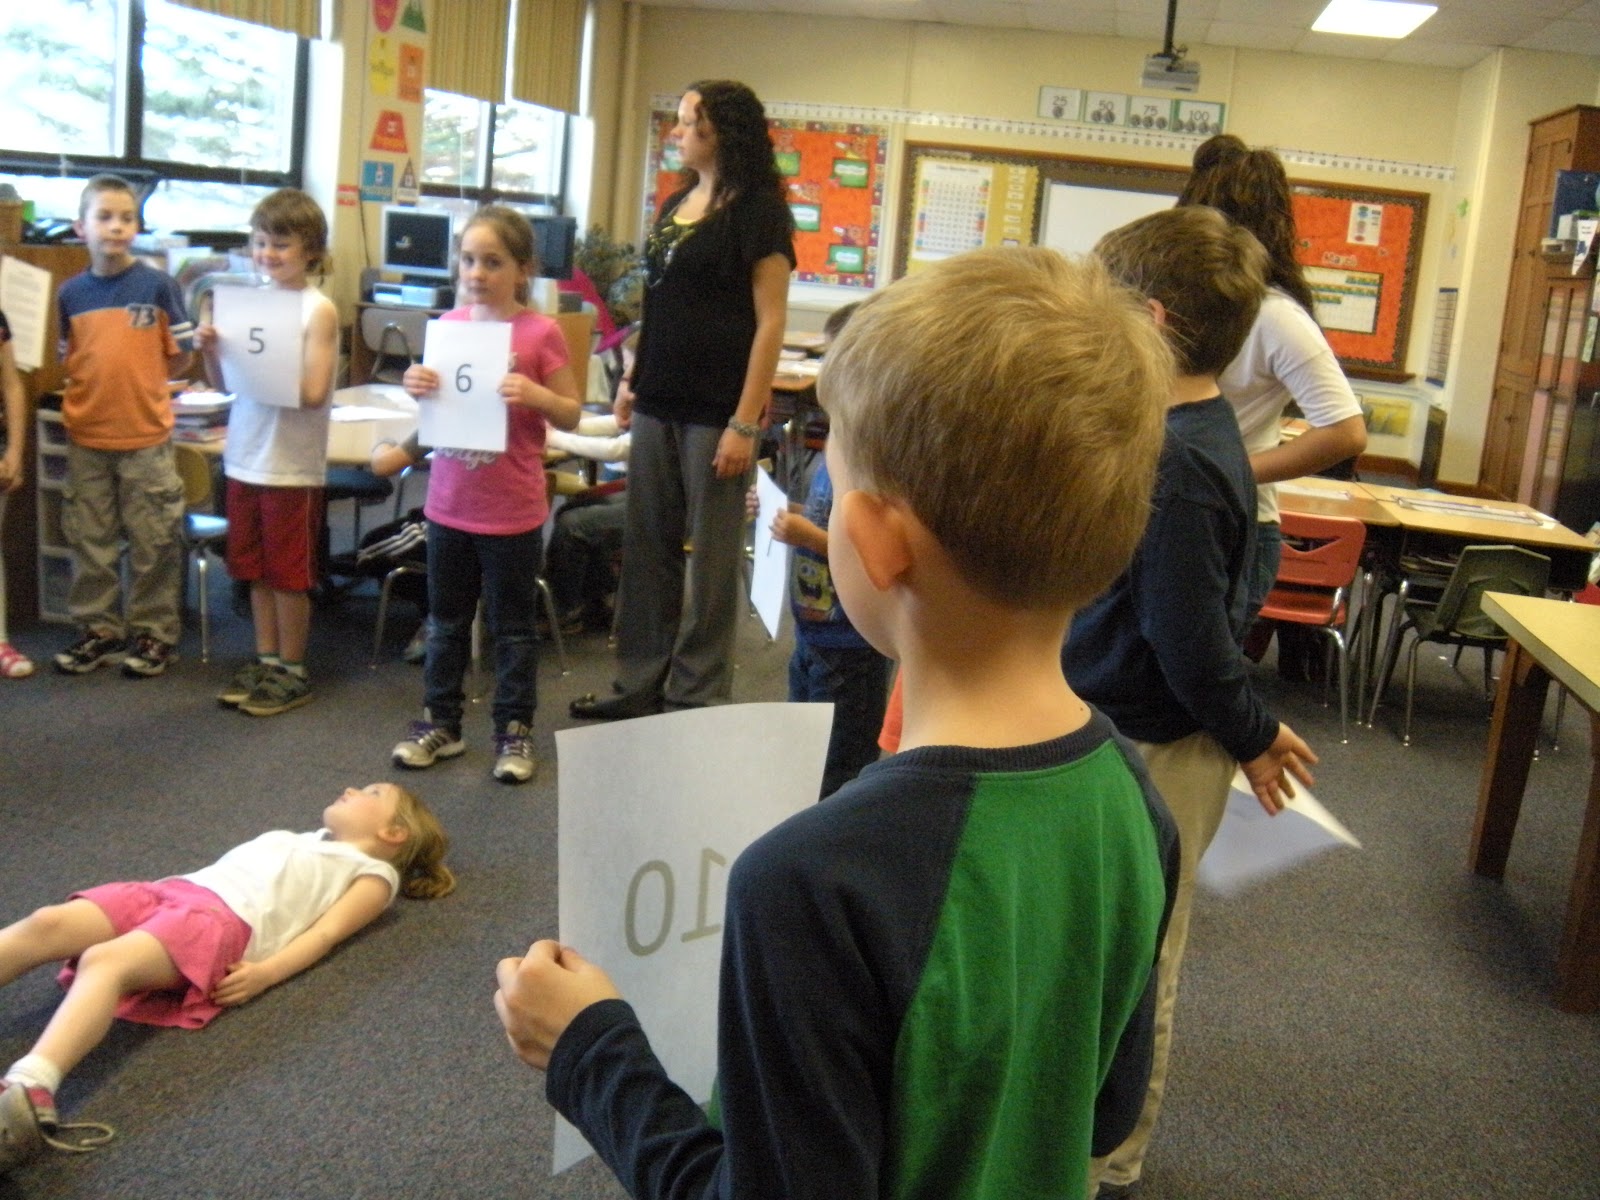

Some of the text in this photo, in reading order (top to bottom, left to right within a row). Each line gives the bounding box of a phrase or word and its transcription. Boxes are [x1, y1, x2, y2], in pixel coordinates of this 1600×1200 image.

[1052, 95, 1068, 106] 25
[1098, 101, 1114, 112] 50
[1143, 104, 1159, 116] 75
[1189, 109, 1210, 121] 100
[126, 303, 157, 328] 73
[247, 327, 266, 354] 5
[455, 363, 472, 393] 6
